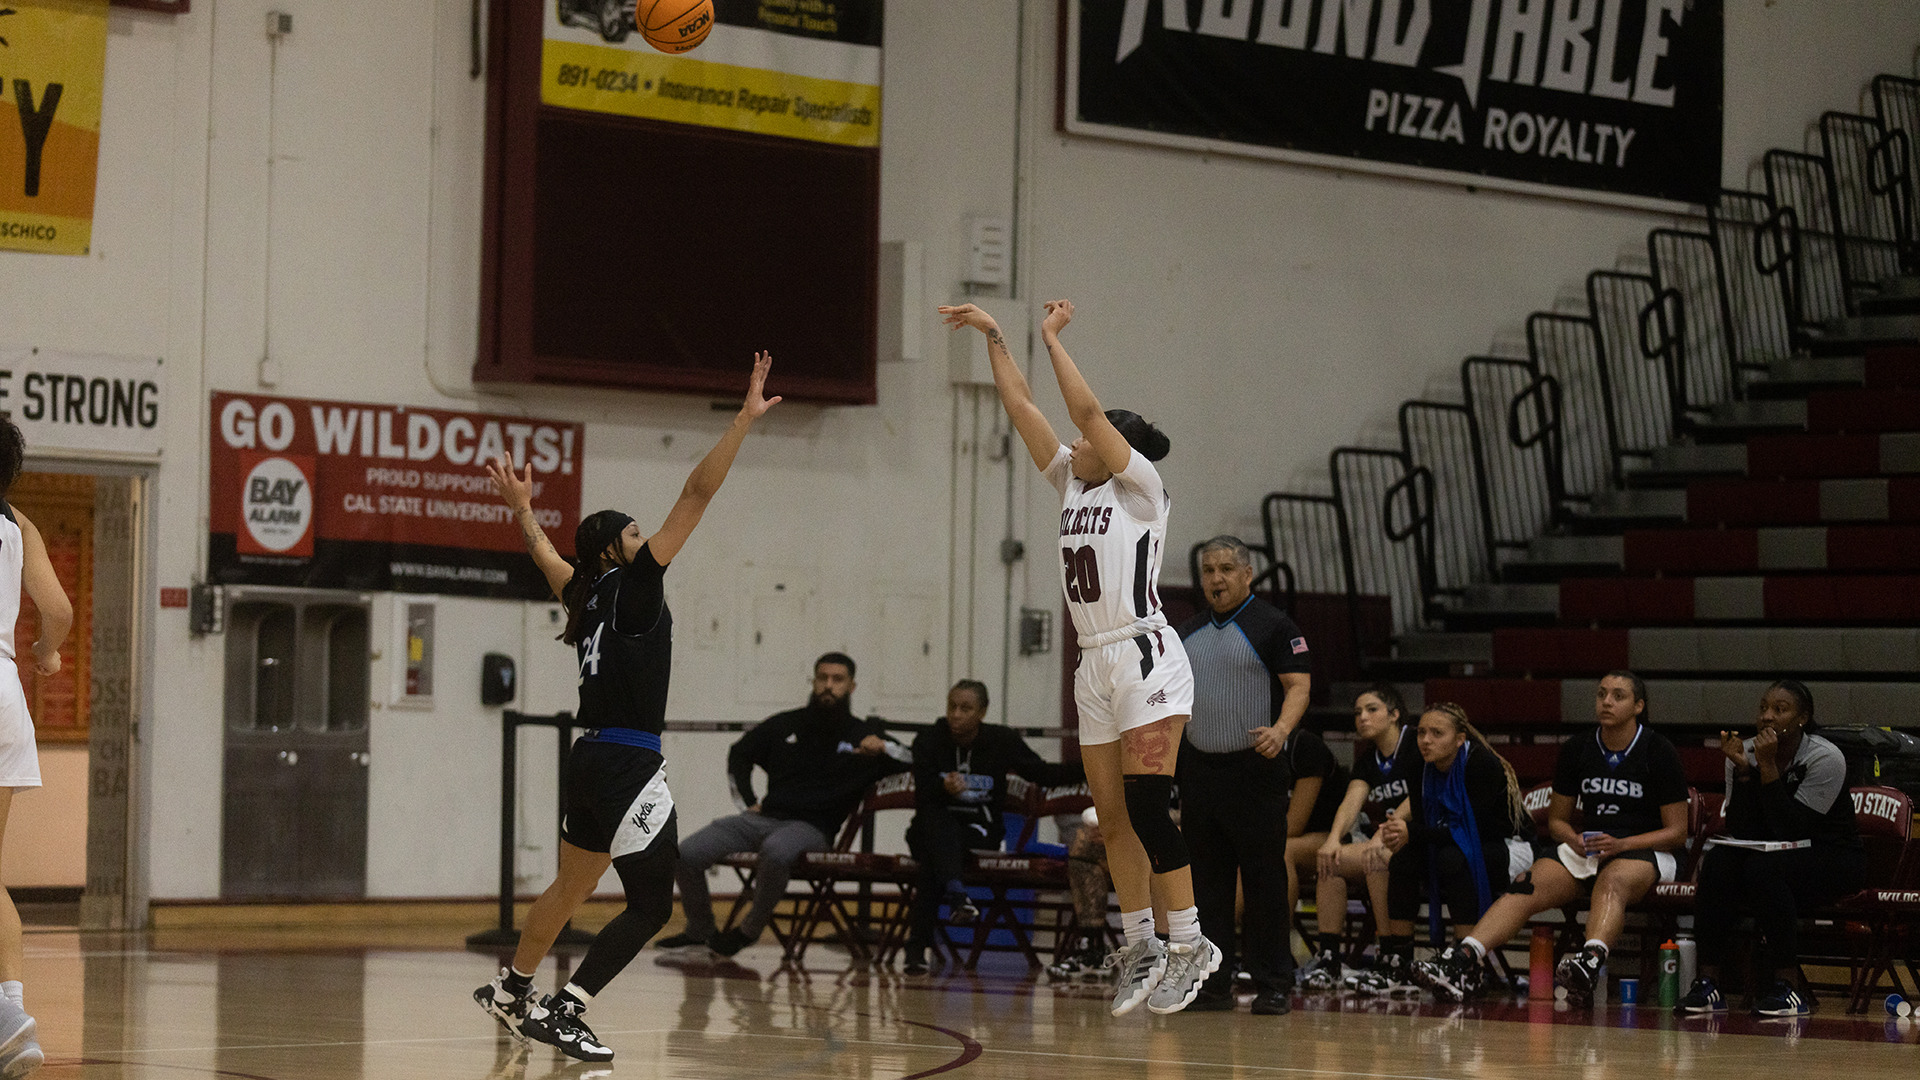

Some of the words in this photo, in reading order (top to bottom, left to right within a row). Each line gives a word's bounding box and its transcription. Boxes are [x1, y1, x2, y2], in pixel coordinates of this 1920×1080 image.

[678, 10, 710, 37] NCAA
[557, 63, 638, 93] 891-0234
[658, 76, 734, 107] Insurance
[736, 87, 791, 116] Repair
[0, 76, 64, 197] Y
[1365, 89, 1464, 145] PIZZA
[1484, 107, 1635, 167] ROYALTY
[23, 372, 158, 429] STRONG
[220, 399, 296, 451] GO
[310, 405, 574, 475] WILDCATS!
[250, 476, 303, 506] BAY
[366, 467, 420, 487] PROUD
[423, 471, 500, 496] SUPPORT
[250, 508, 301, 525] ALARM
[343, 493, 375, 513] CAL
[379, 495, 423, 517] STATE
[426, 500, 514, 524] UNIVERSITY
[1062, 544, 1102, 604] 20
[578, 621, 605, 687] 24
[1523, 786, 1553, 811] CHIC
[1581, 776, 1645, 798] CSUSB
[1863, 791, 1902, 823] STATE
[978, 858, 1030, 870] WILDCATS
[1656, 884, 1696, 897] WILDC
[1877, 890, 1920, 904] WILDC
[1664, 959, 1677, 974] G
